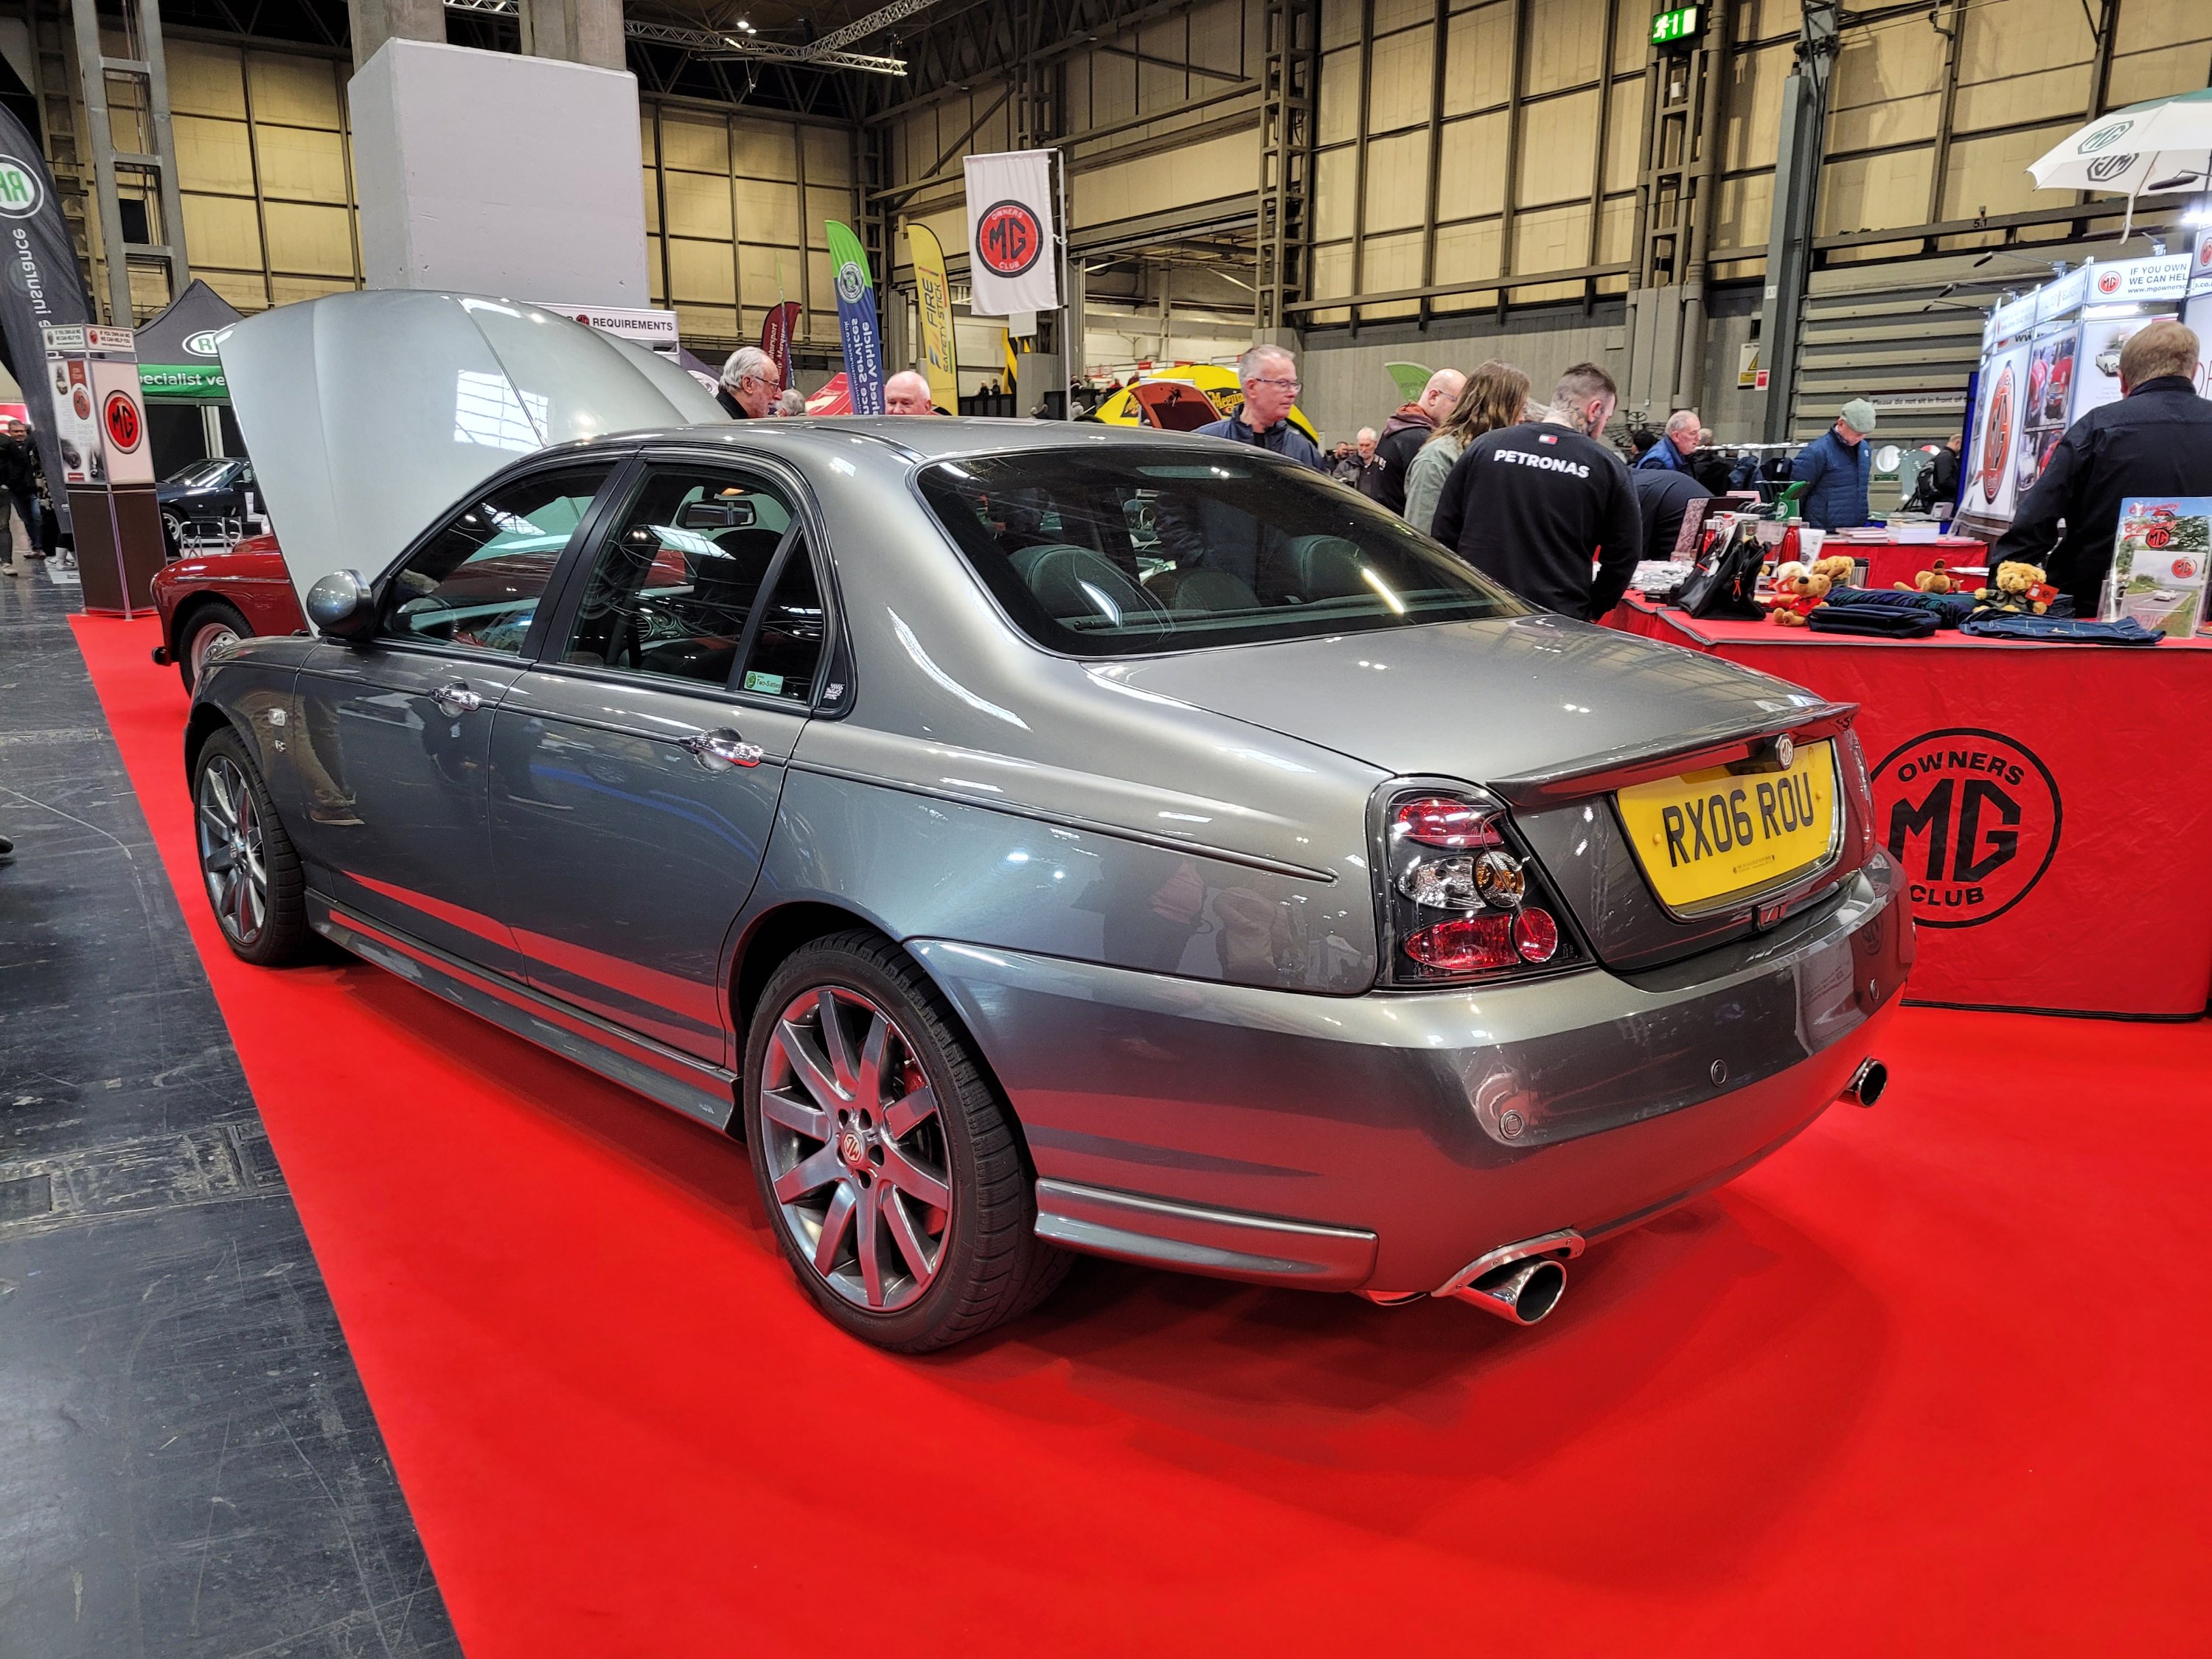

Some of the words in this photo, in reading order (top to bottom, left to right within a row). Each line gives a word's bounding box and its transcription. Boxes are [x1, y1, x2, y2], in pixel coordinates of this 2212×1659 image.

[2085, 125, 2126, 149] MG
[991, 208, 1024, 220] OWNERS
[1973, 218, 1987, 228] 5.1
[990, 217, 1026, 260] MG
[998, 260, 1020, 270] CLUB
[2130, 267, 2139, 275] IF
[2142, 265, 2161, 274] YOU
[2164, 263, 2187, 273] OWN
[2103, 276, 2116, 289] MG
[2129, 277, 2143, 285] WE
[2146, 275, 2166, 284] CAN
[2169, 273, 2188, 282] HEL
[922, 277, 939, 328] FIRE
[933, 282, 945, 320] STICK
[593, 317, 673, 331] REQUIREMENTS
[939, 322, 950, 372] SAFETY
[139, 372, 203, 386] ecialist
[1207, 391, 1245, 414] Meguia
[112, 405, 134, 439] MG
[1493, 449, 1591, 479] PETRONAS
[2149, 531, 2167, 546] MG
[1897, 751, 2025, 786] OWNERS
[1661, 788, 1754, 868] RX06
[1756, 771, 1814, 840] ROU
[1888, 778, 2022, 883] MG
[1910, 885, 1985, 907] CLUB
